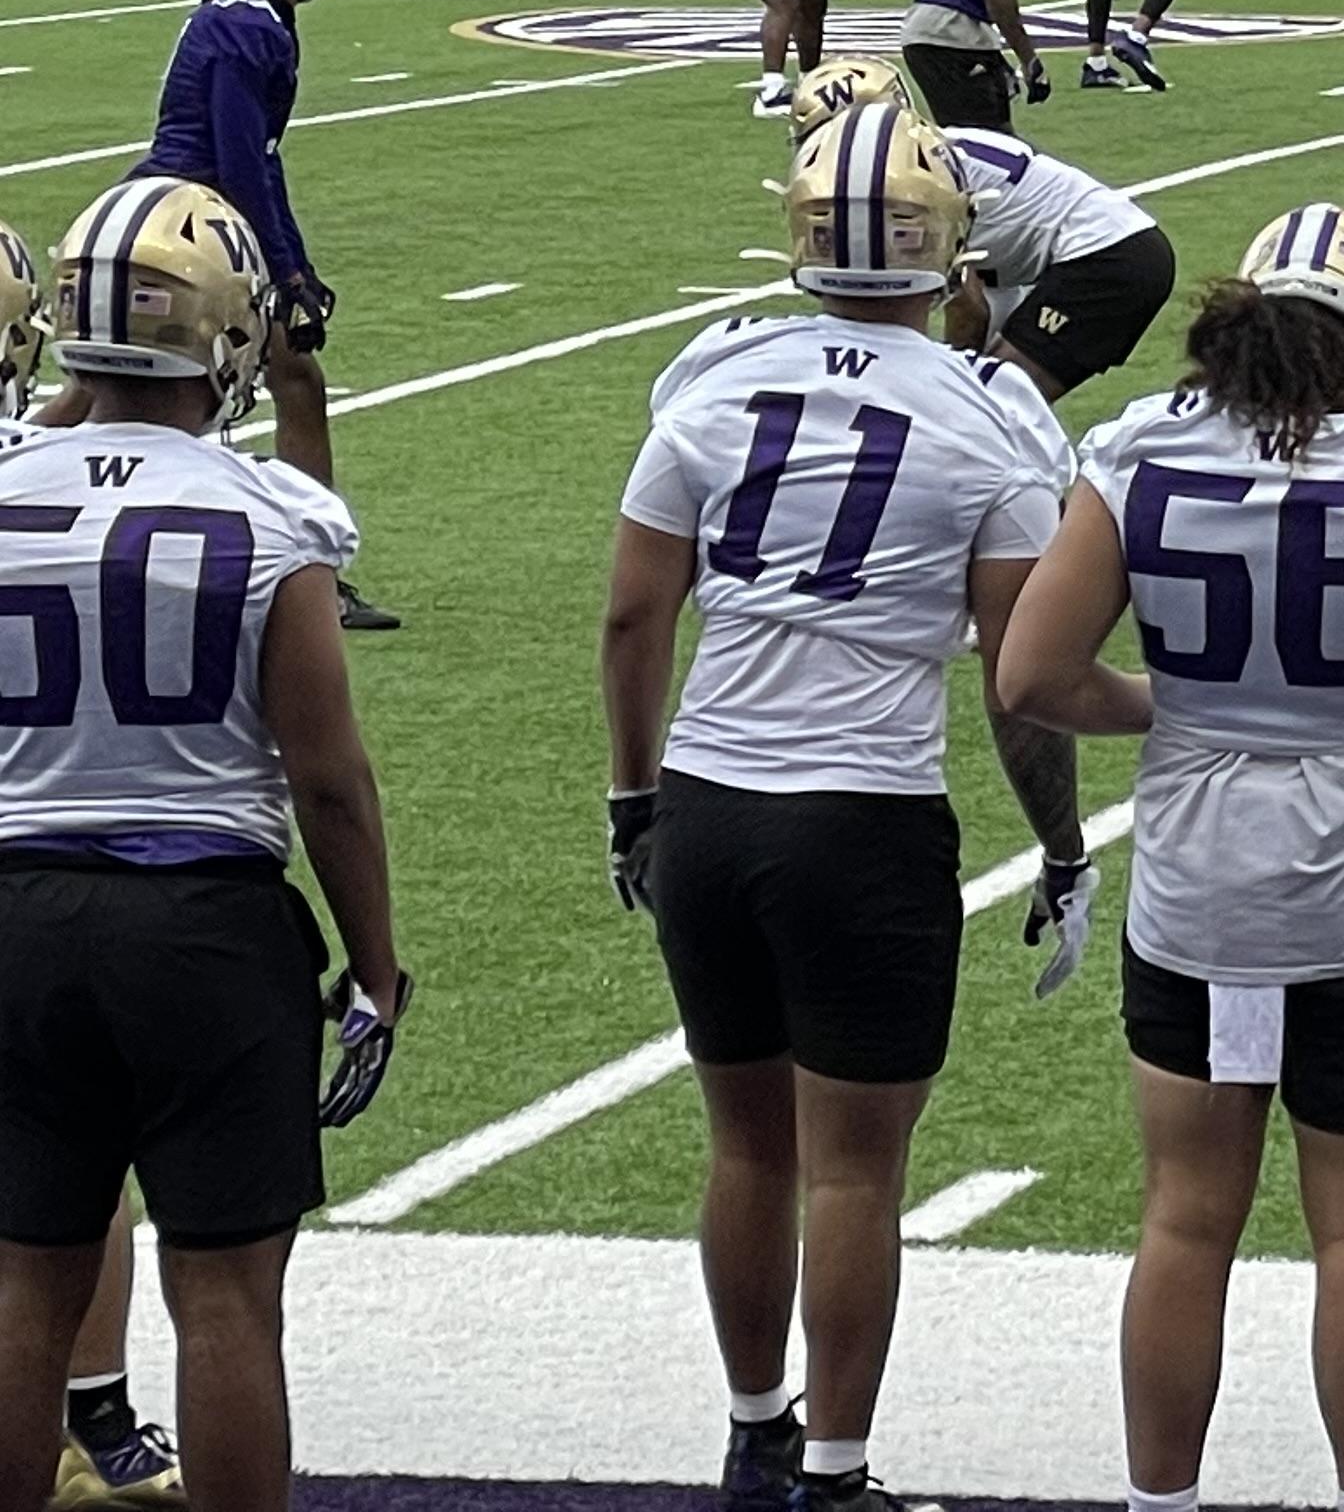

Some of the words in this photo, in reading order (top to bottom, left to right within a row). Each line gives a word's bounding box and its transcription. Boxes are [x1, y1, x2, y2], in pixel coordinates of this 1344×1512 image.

[1036, 306, 1069, 335] W
[822, 345, 879, 380] W
[83, 455, 145, 489] W
[708, 389, 912, 603] 11
